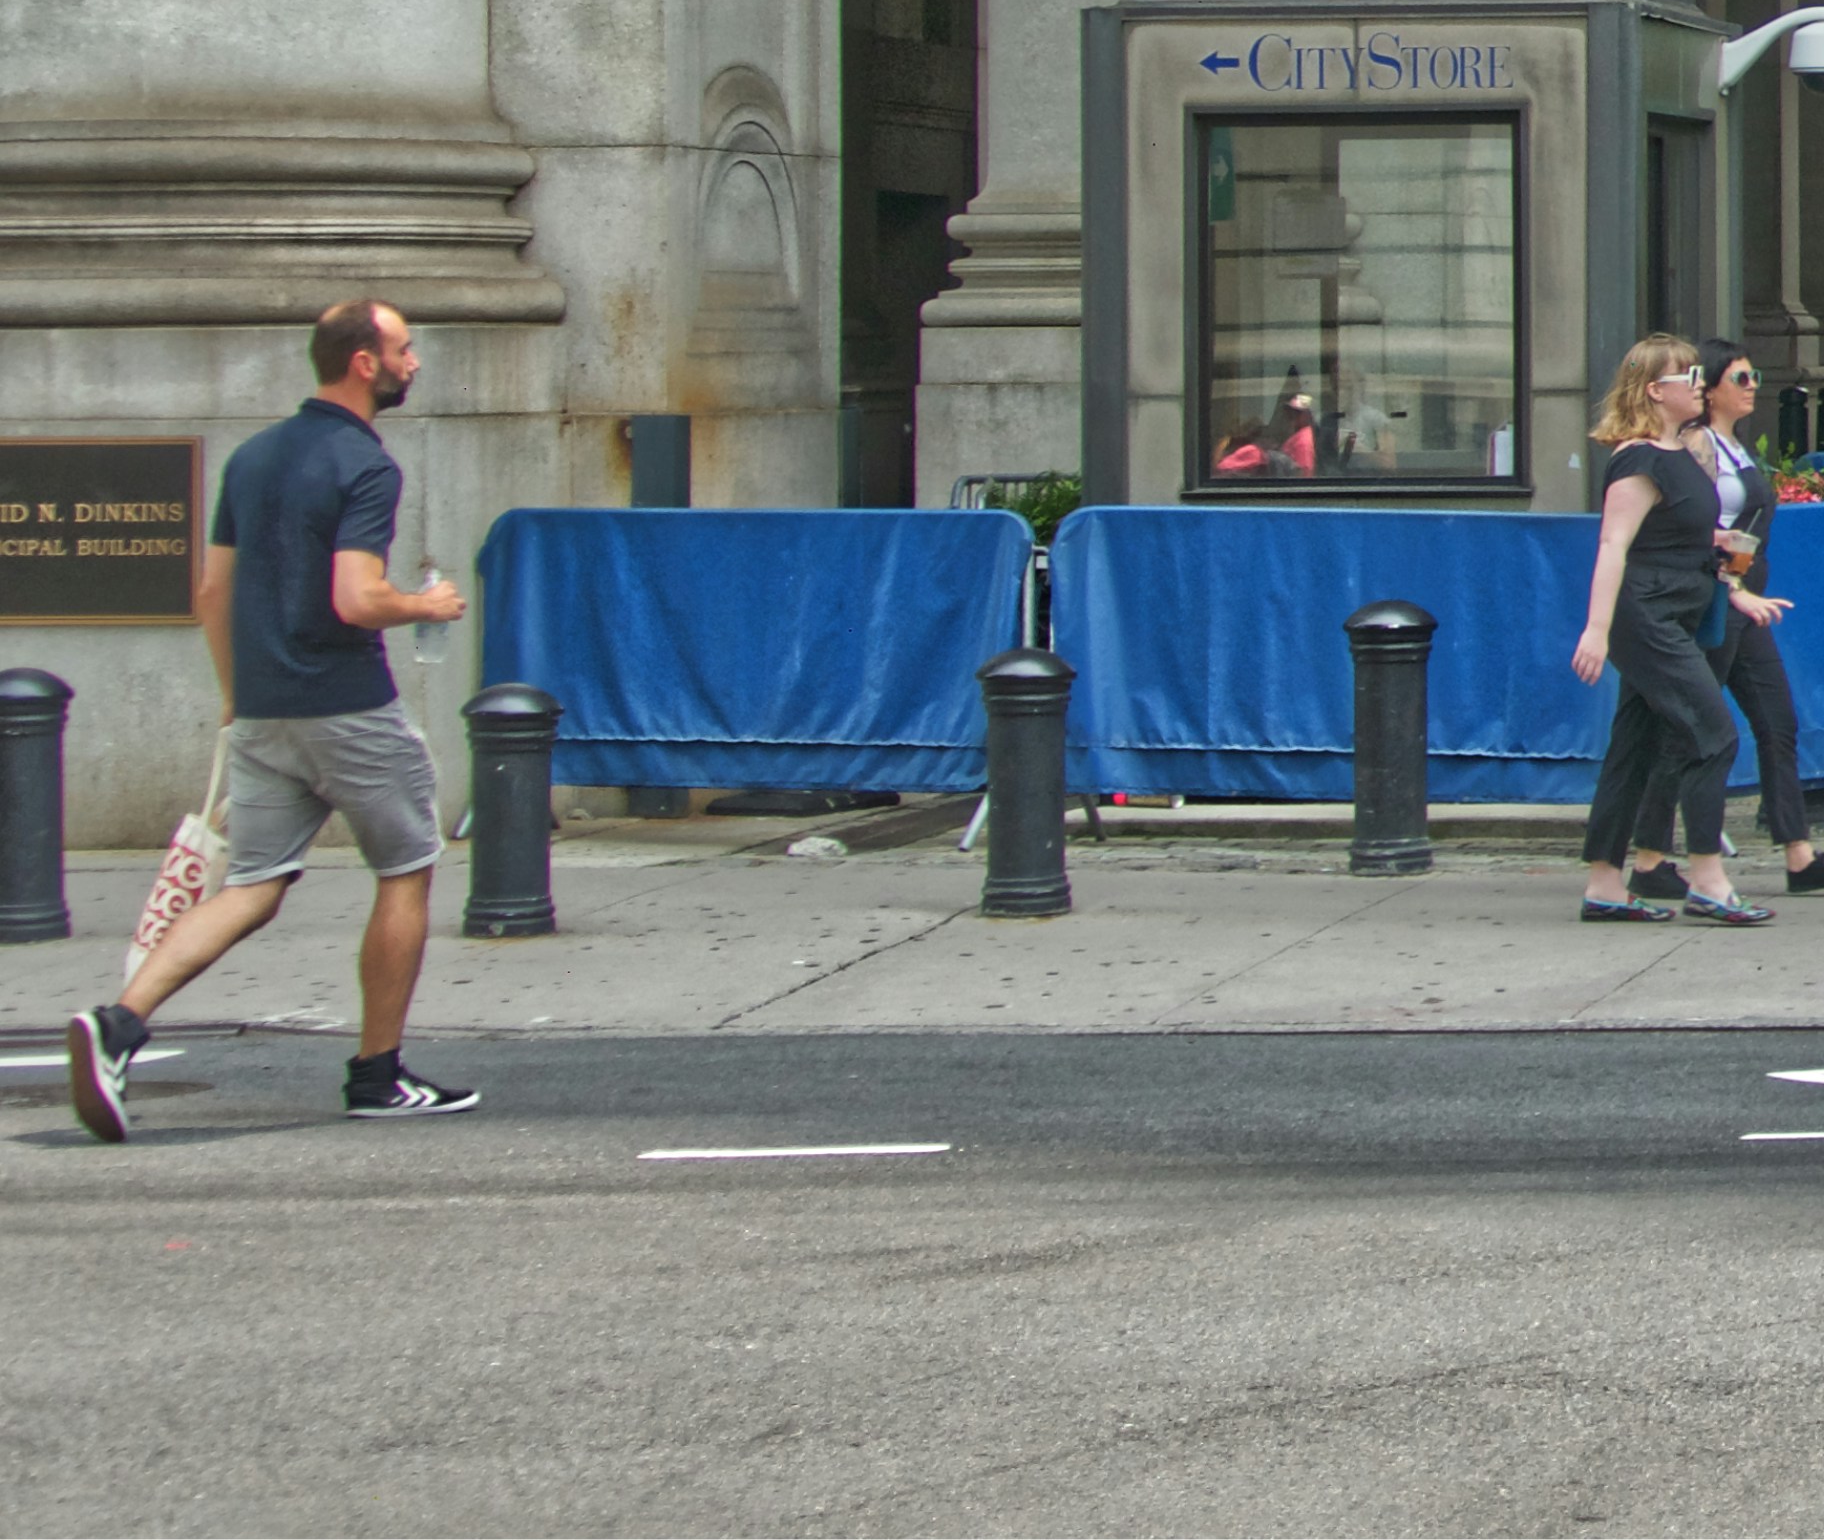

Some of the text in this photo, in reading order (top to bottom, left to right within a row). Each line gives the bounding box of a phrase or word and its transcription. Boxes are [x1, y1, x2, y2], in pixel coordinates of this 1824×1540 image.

[38, 503, 65, 523] N.
[74, 502, 185, 523] DINKINS
[76, 538, 187, 557] BUILDING
